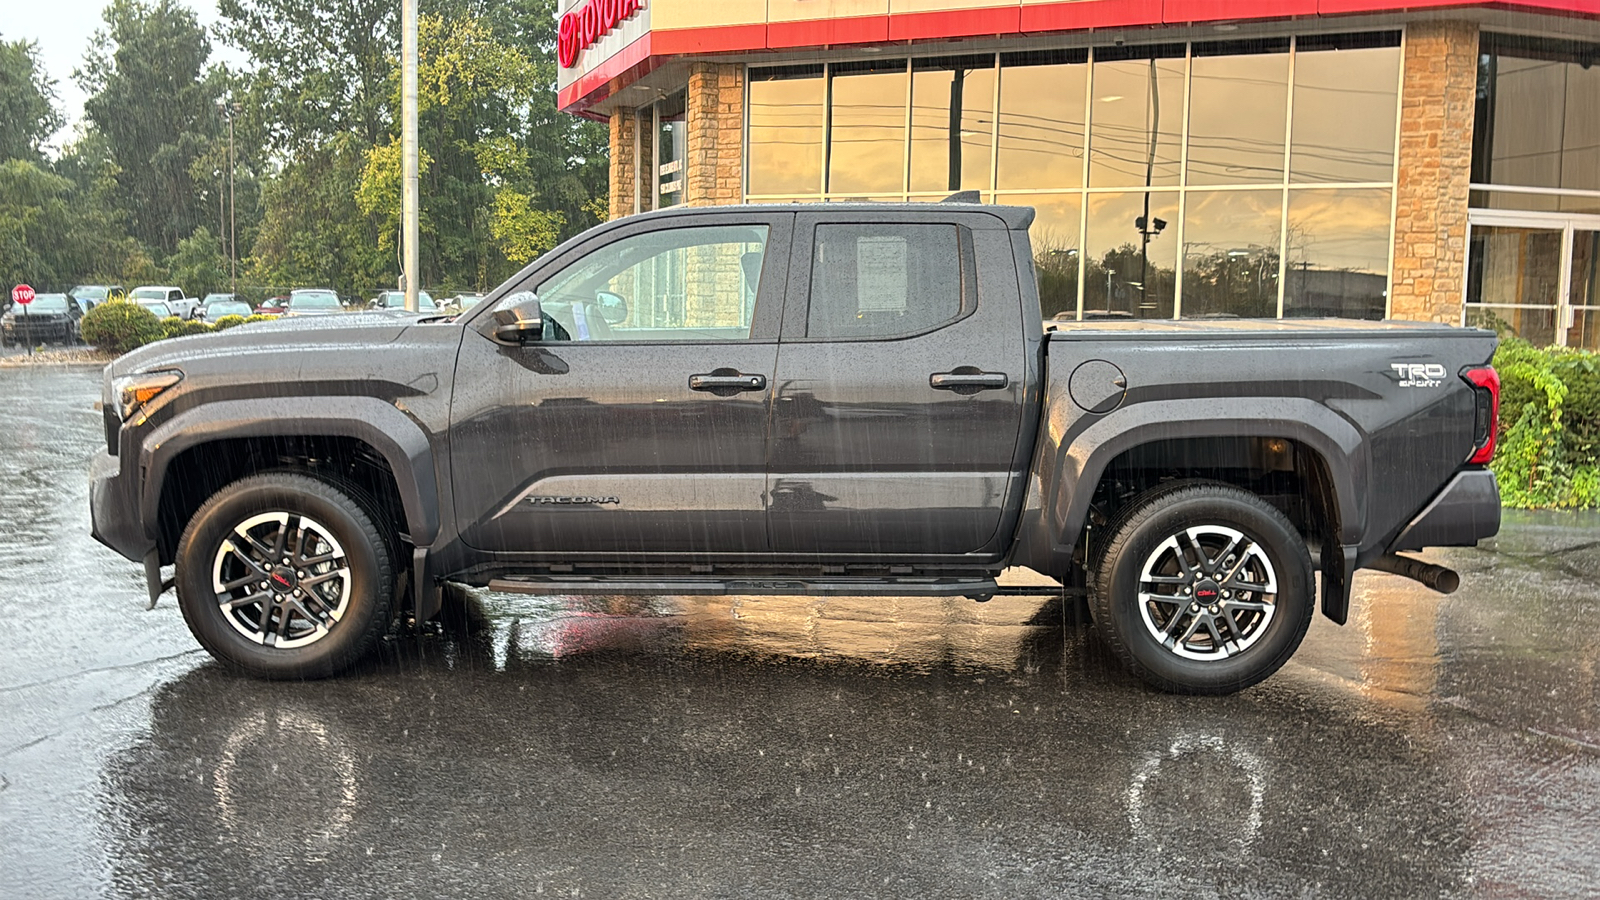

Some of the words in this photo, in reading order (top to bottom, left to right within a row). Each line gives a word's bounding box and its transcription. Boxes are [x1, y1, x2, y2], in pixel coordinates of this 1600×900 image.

[577, 0, 640, 50] TOYOT
[14, 290, 34, 300] STOP
[1391, 363, 1446, 380] TRD
[525, 496, 620, 504] TACOMA
